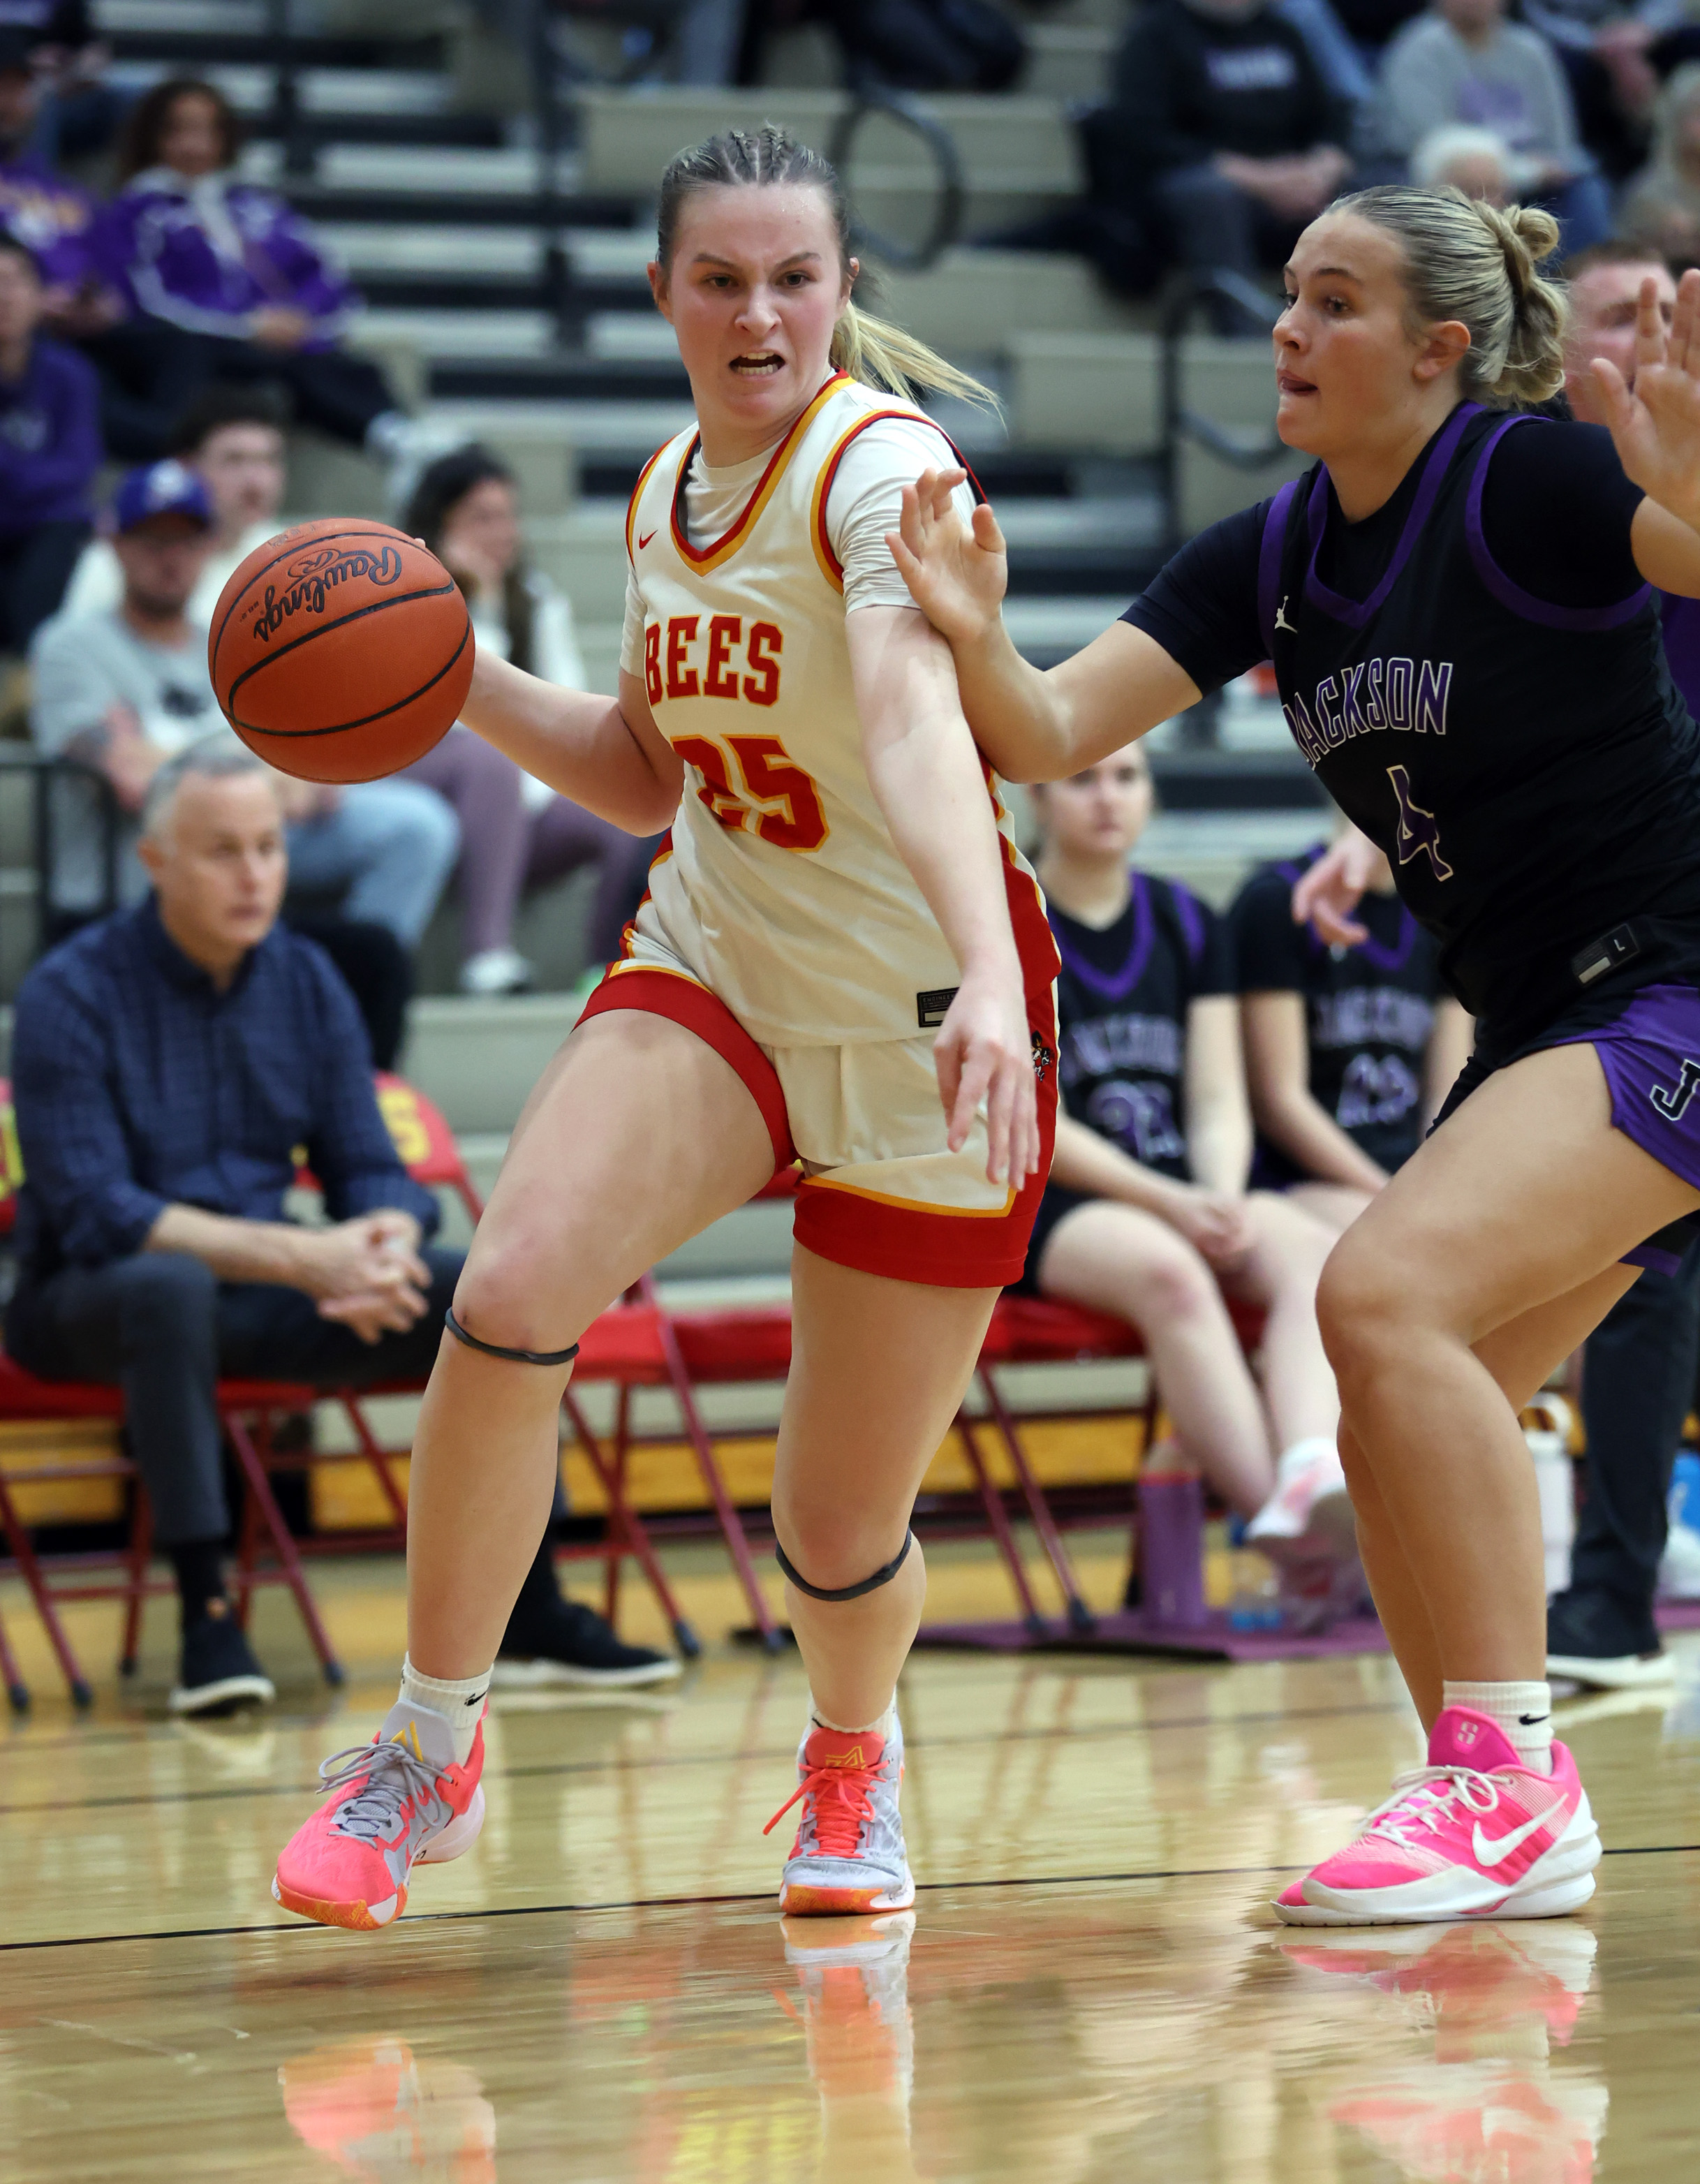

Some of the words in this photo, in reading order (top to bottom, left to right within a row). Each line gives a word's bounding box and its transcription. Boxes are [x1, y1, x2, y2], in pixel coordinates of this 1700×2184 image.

[253, 546, 402, 642] Rawlings
[645, 614, 784, 708] BEES
[670, 734, 830, 853] 25
[1386, 764, 1454, 883] 4
[1613, 939, 1626, 952] L
[1649, 1058, 1700, 1121] J
